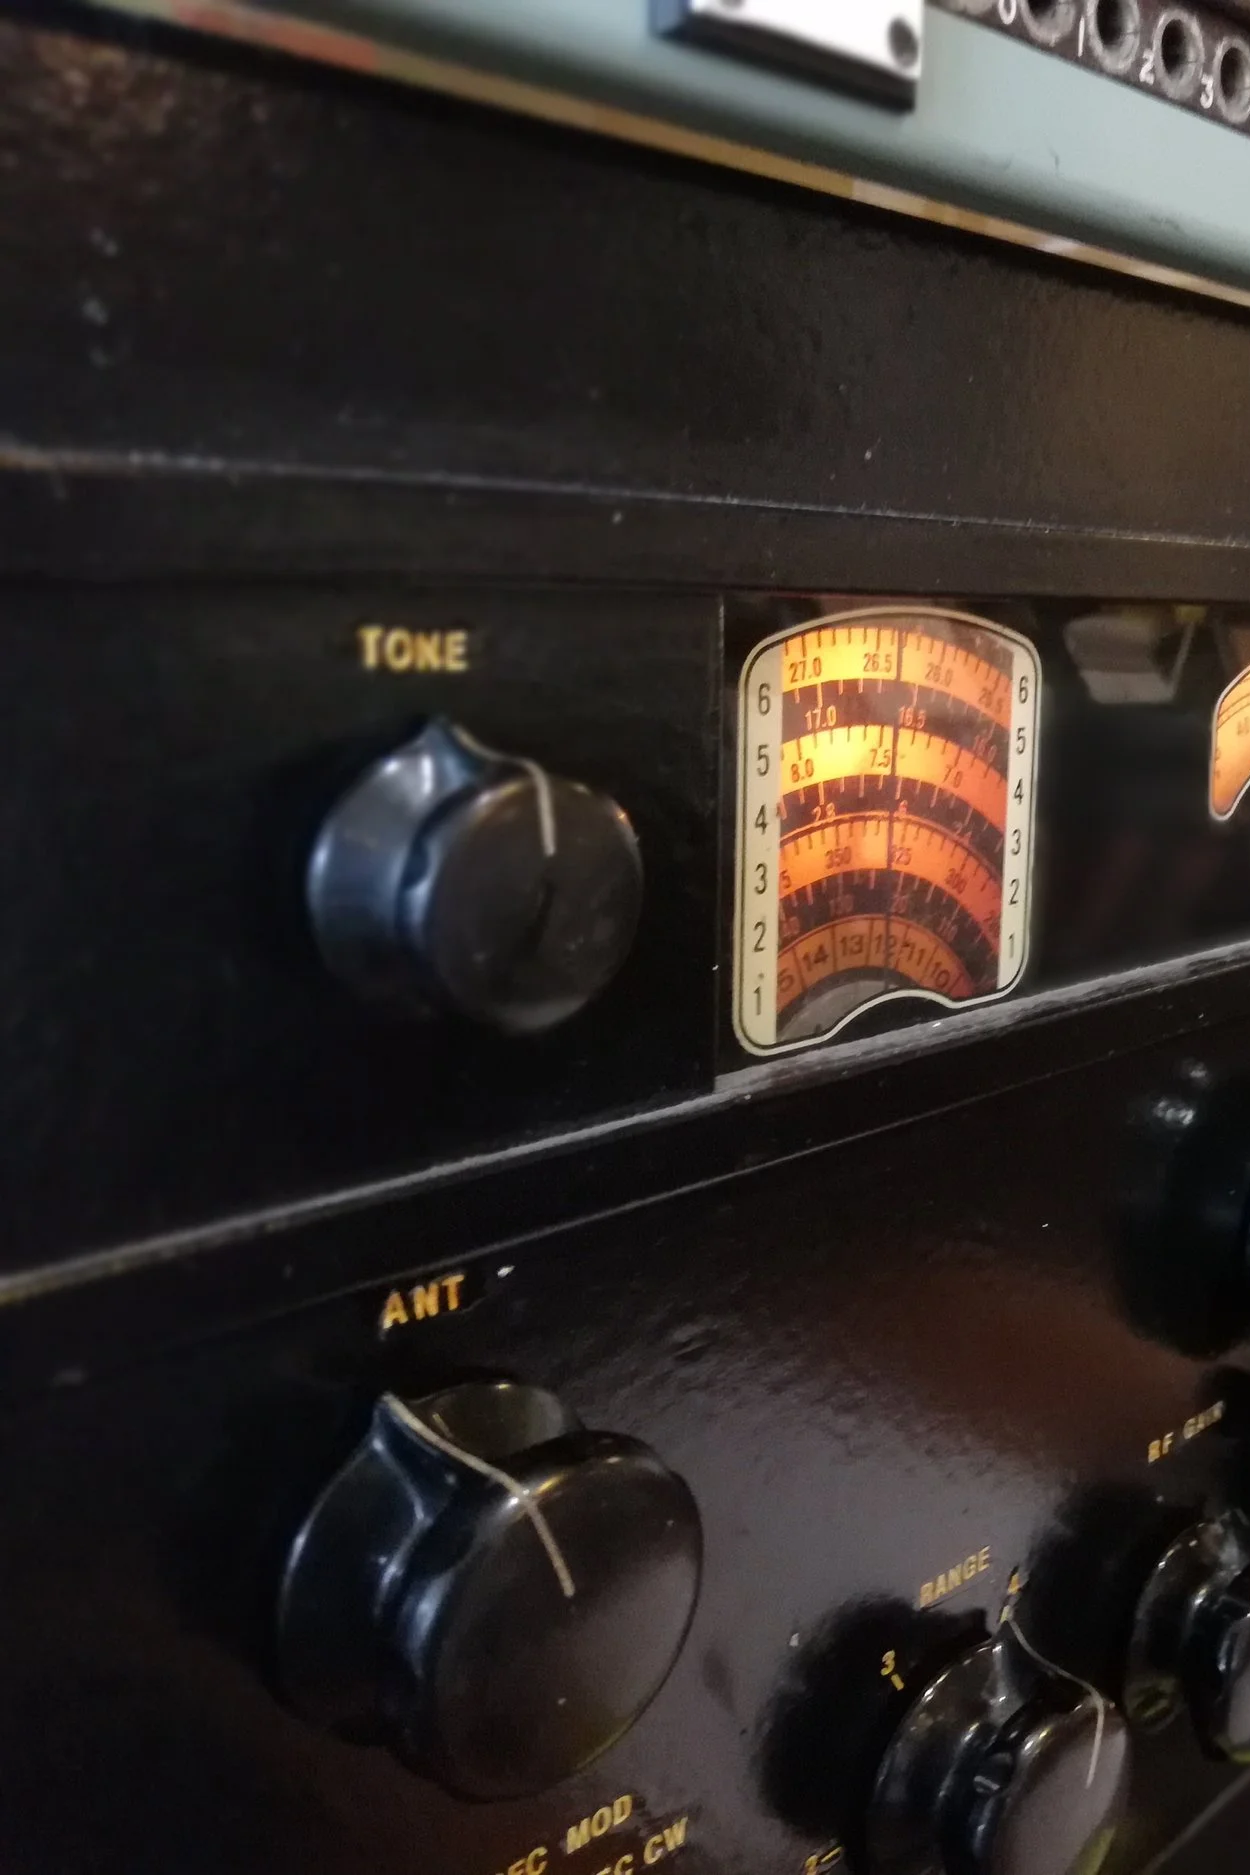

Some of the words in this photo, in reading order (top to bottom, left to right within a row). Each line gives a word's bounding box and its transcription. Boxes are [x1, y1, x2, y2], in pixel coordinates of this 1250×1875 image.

[1139, 49, 1154, 85] 2
[1200, 73, 1214, 109] 3
[359, 624, 468, 672] TONE
[788, 656, 822, 684] 27.0
[863, 652, 892, 673] 26.5
[758, 683, 771, 716] 6
[1018, 675, 1029, 704] 6
[804, 705, 838, 731] 17.0
[1015, 727, 1026, 755] 5
[758, 744, 771, 776] 5
[790, 758, 815, 783] 8.0
[869, 747, 891, 769] 7.5
[1013, 778, 1024, 806] 4
[755, 804, 768, 834] 4
[1010, 828, 1021, 856] 3
[754, 863, 768, 895] 3
[1009, 878, 1020, 905] 2
[753, 921, 767, 953] 2
[1007, 932, 1016, 959] 1
[803, 943, 828, 972] 14
[839, 934, 865, 956] 13
[931, 960, 951, 988] 10
[754, 986, 764, 1016] 1
[382, 1274, 465, 1330] ANT
[919, 1545, 990, 1609] RANGE
[881, 1649, 896, 1676] 3
[495, 1846, 548, 1875] EC
[566, 1794, 632, 1854] MOD
[643, 1816, 688, 1865] CW
